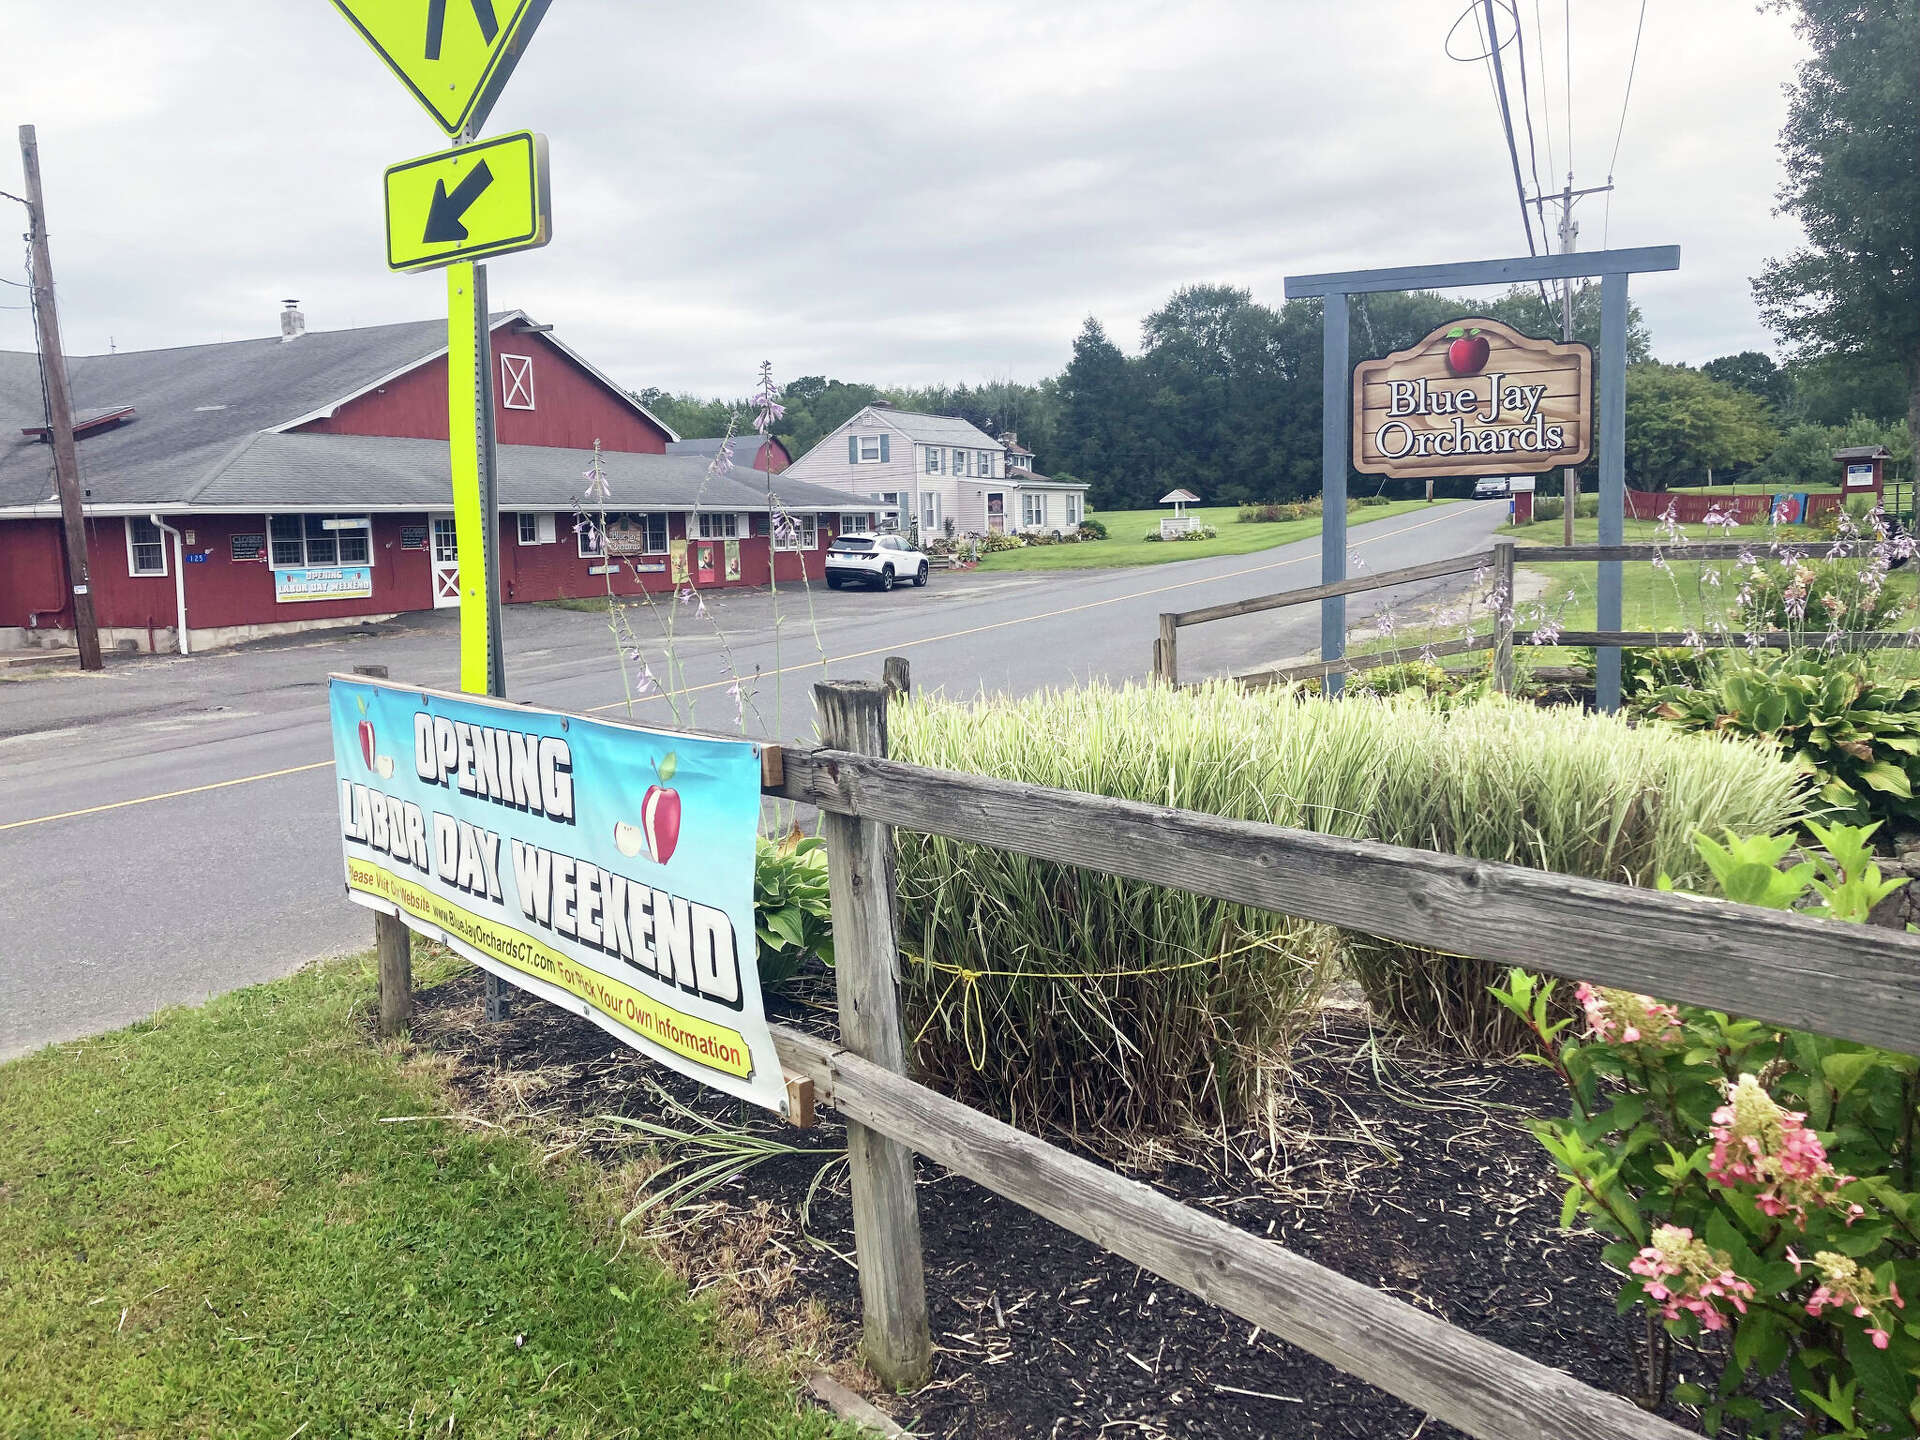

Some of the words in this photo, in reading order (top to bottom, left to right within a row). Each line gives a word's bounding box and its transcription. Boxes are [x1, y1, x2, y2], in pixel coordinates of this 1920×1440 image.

[1386, 377, 1477, 418] Blue
[1478, 373, 1547, 425] Jay
[1375, 412, 1565, 459] Orchards
[278, 584, 309, 594] LABOR
[311, 582, 329, 592] DAY
[330, 580, 370, 591] WEEKEND
[306, 571, 343, 580] OPENING
[413, 711, 576, 826] OPENING
[341, 778, 430, 875] LABOR
[433, 811, 504, 906] DAY
[510, 837, 744, 1012] WEEKEND
[391, 880, 400, 897] Or
[400, 887, 430, 912] Website
[433, 905, 556, 975] www.BlueJayOrchardsCT.com
[557, 960, 575, 986] For
[575, 968, 596, 998] Pick
[597, 982, 623, 1014] Your
[626, 998, 653, 1030] Own
[654, 1010, 741, 1066] Information
